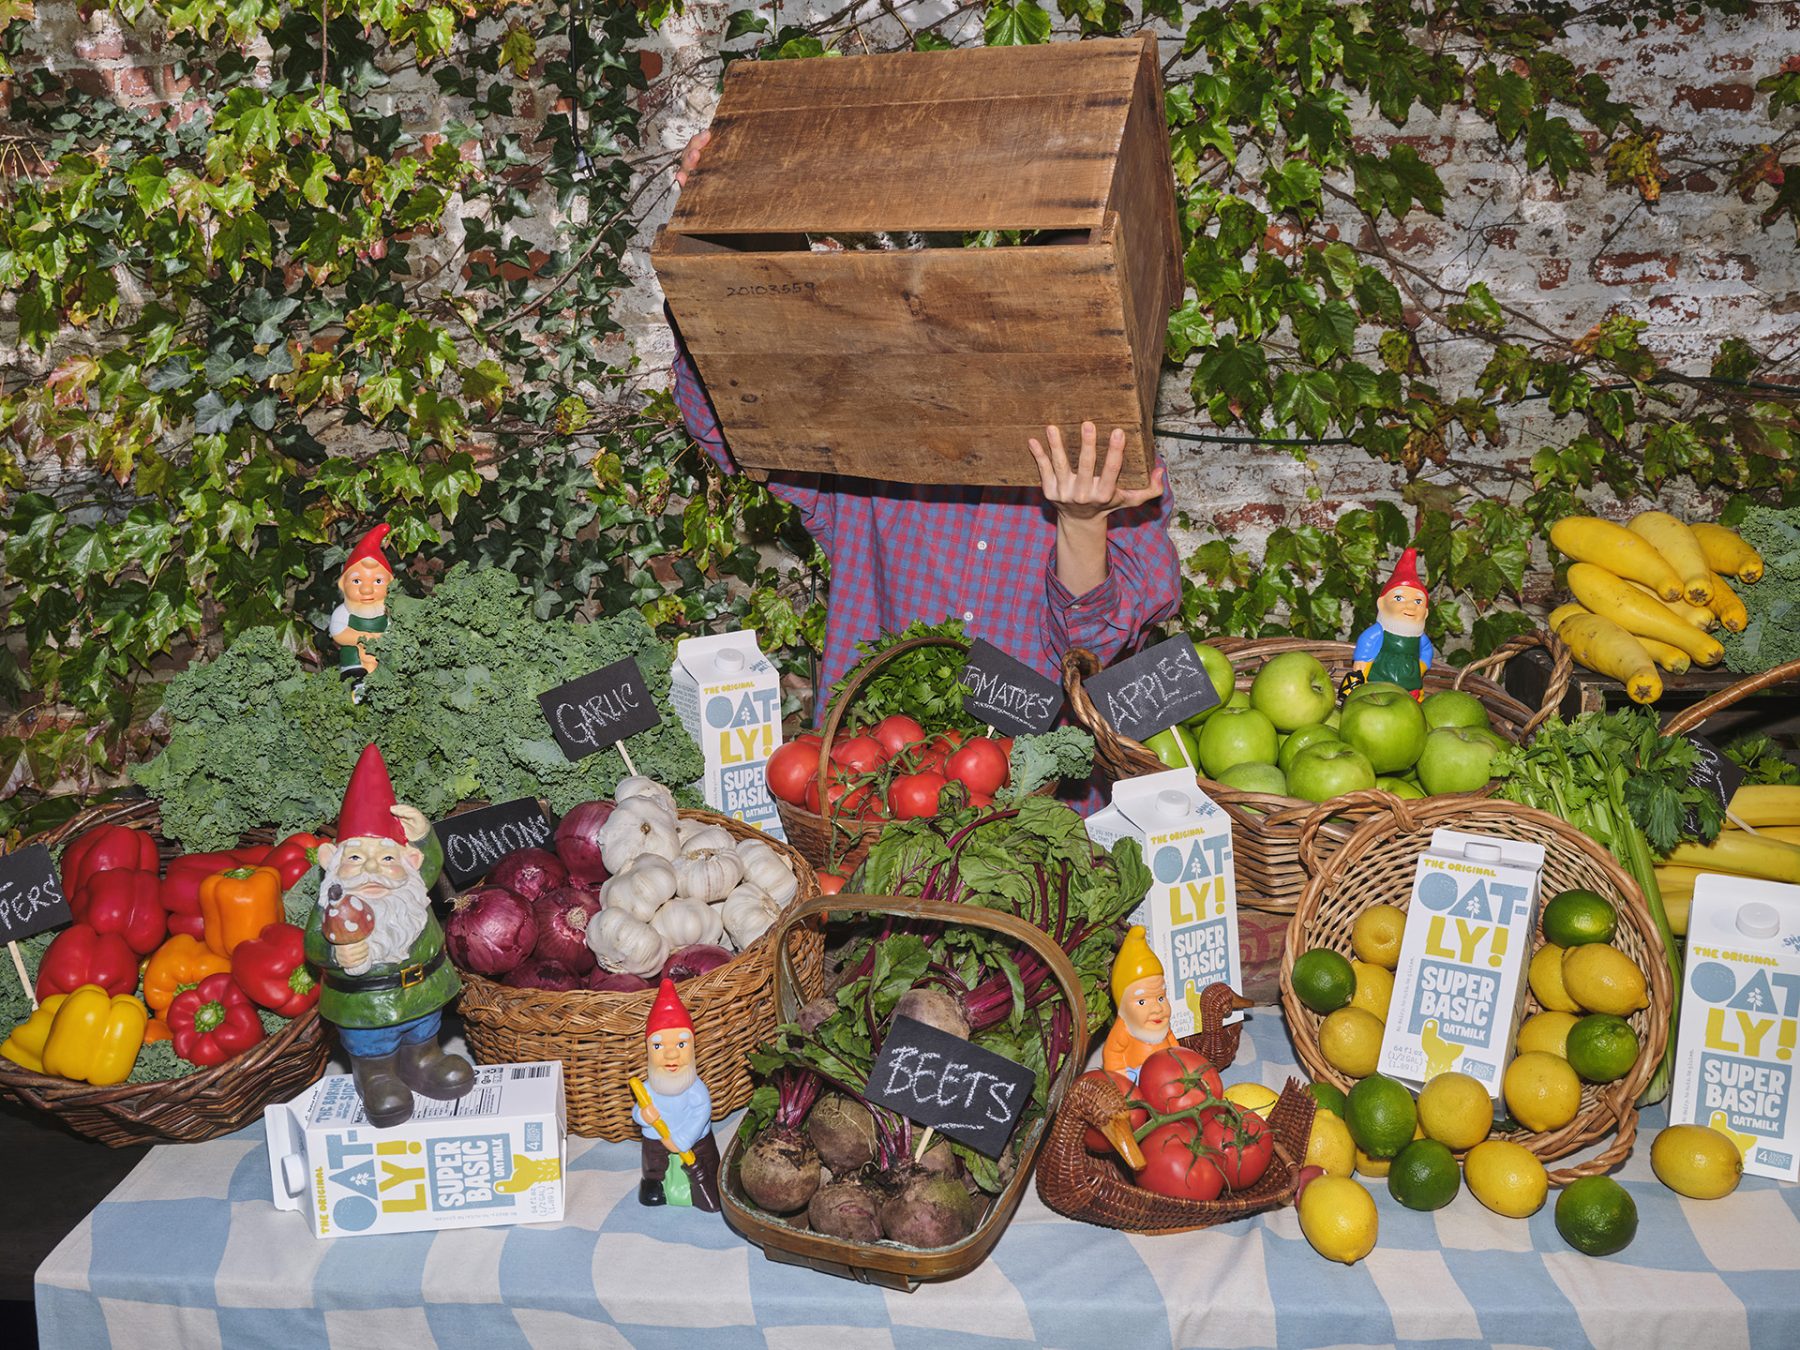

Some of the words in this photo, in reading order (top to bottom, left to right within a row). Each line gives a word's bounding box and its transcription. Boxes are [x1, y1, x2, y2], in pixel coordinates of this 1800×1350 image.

[704, 687, 719, 695] THE
[721, 681, 755, 692] ORIGINAL
[1107, 648, 1199, 735] APPLES
[556, 683, 638, 747] GARLIC
[720, 724, 773, 764] LY!
[745, 805, 773, 818] OATMILK
[447, 815, 551, 872] ONIONS
[1150, 834, 1168, 845] THE
[1169, 827, 1206, 841] ORIGINAL
[1153, 833, 1232, 884] OAT-
[1424, 859, 1444, 870] THE
[1448, 863, 1496, 877] ORIGINAL
[1169, 876, 1225, 926] LY!
[1418, 872, 1528, 926] OAT-
[1174, 925, 1225, 957] SUPER
[1425, 915, 1509, 967] LY!
[1693, 946, 1719, 959] THE
[1722, 950, 1780, 967] ORIGINAL
[1178, 947, 1225, 980] BASIC
[1421, 966, 1495, 1002] SUPER
[1691, 961, 1800, 1018] OAT
[1420, 991, 1489, 1026] BASIC
[1443, 1023, 1486, 1040] OATMILK
[1705, 1007, 1798, 1060] LY!
[882, 1046, 1016, 1124] BEETS
[1704, 1059, 1786, 1095] SUPER
[315, 1104, 333, 1124] THE
[324, 1077, 347, 1106] BORING
[1705, 1083, 1781, 1118] BASIC
[1732, 1115, 1779, 1132] OATMILK
[434, 1141, 465, 1208] SUPER
[461, 1140, 493, 1203] BASIC
[492, 1138, 505, 1178] OATMILK
[1758, 1150, 1768, 1162] 4
[315, 1166, 328, 1211] ORIGINAL
[325, 1130, 378, 1232] OAT-
[376, 1140, 427, 1213] LY!
[320, 1211, 330, 1235] THE
